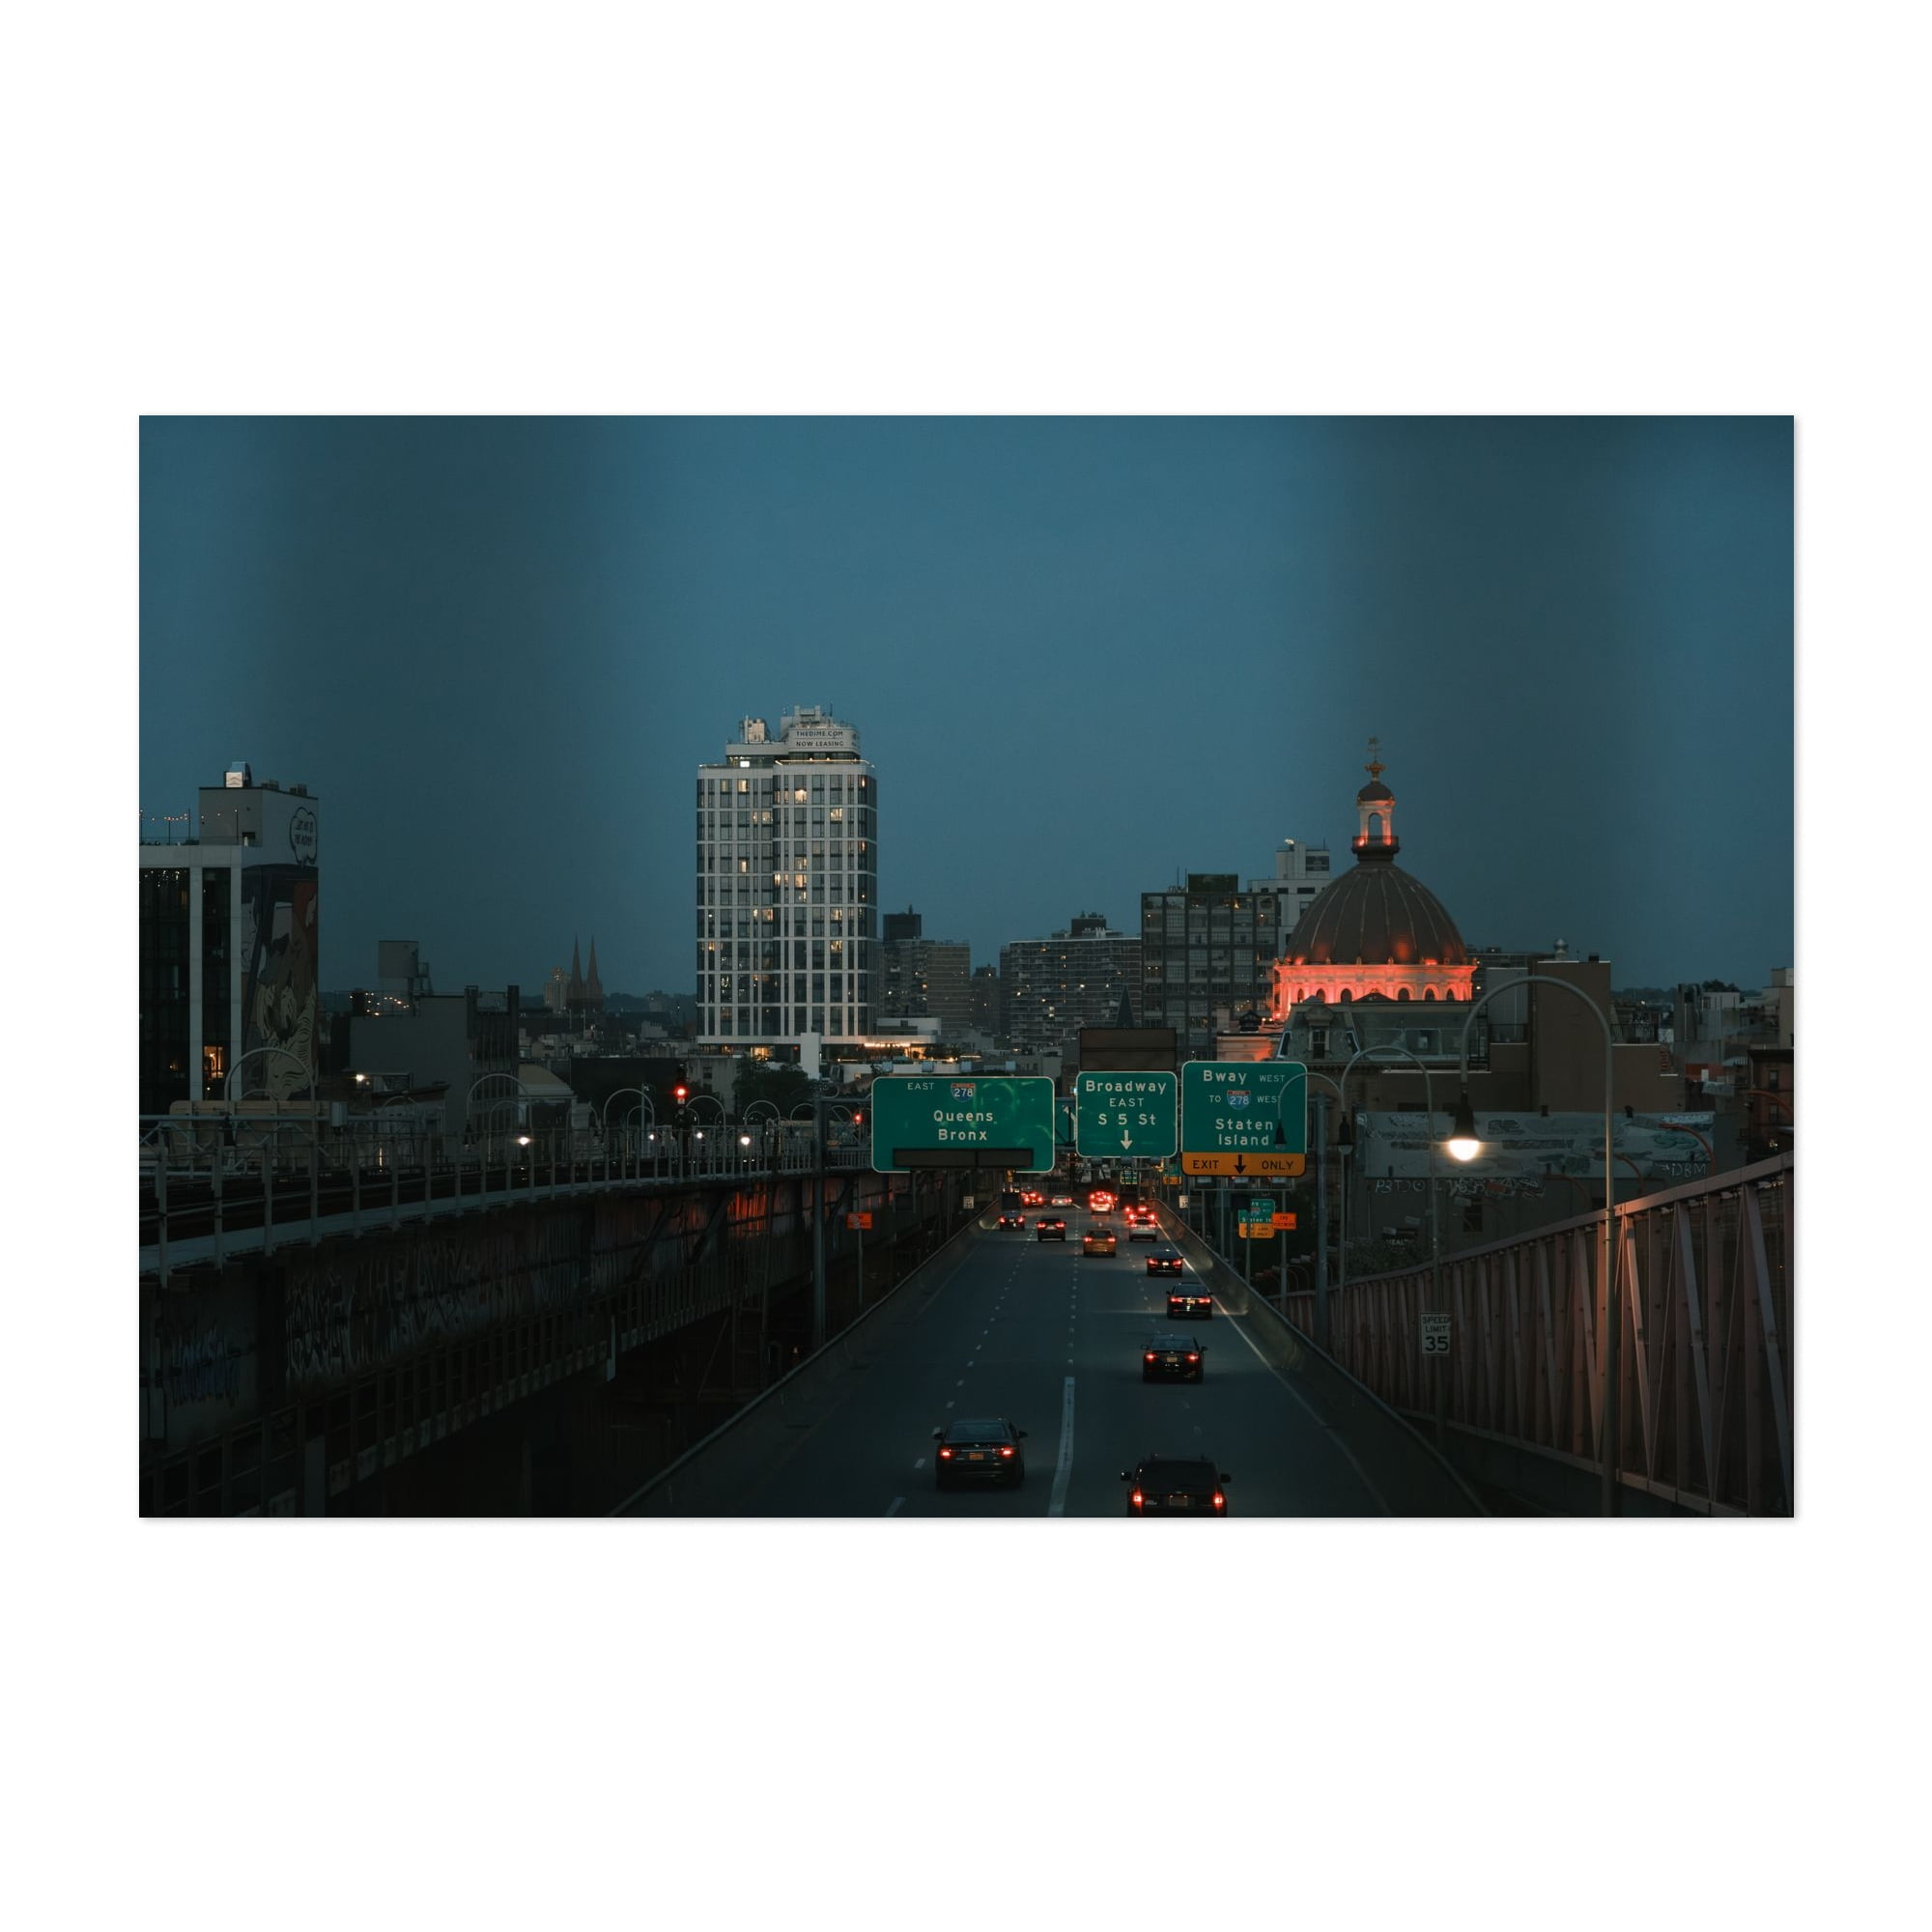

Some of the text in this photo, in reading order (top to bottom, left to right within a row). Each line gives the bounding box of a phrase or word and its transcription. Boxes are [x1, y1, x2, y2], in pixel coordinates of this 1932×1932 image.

[1203, 1069, 1286, 1085] Bway WEST
[907, 1082, 974, 1097] EAST 278
[1086, 1080, 1167, 1094] Broadway
[1109, 1097, 1145, 1107] EAST
[1209, 1094, 1222, 1103] TO
[1230, 1095, 1250, 1106] 278
[933, 1109, 994, 1122] Queens
[1097, 1113, 1156, 1125] S 5 St
[1215, 1118, 1273, 1130] Staten
[938, 1128, 988, 1141] Bronx
[1219, 1133, 1269, 1146] Island
[1193, 1160, 1294, 1171] EXIT ONLY
[1425, 1336, 1449, 1351] 35
